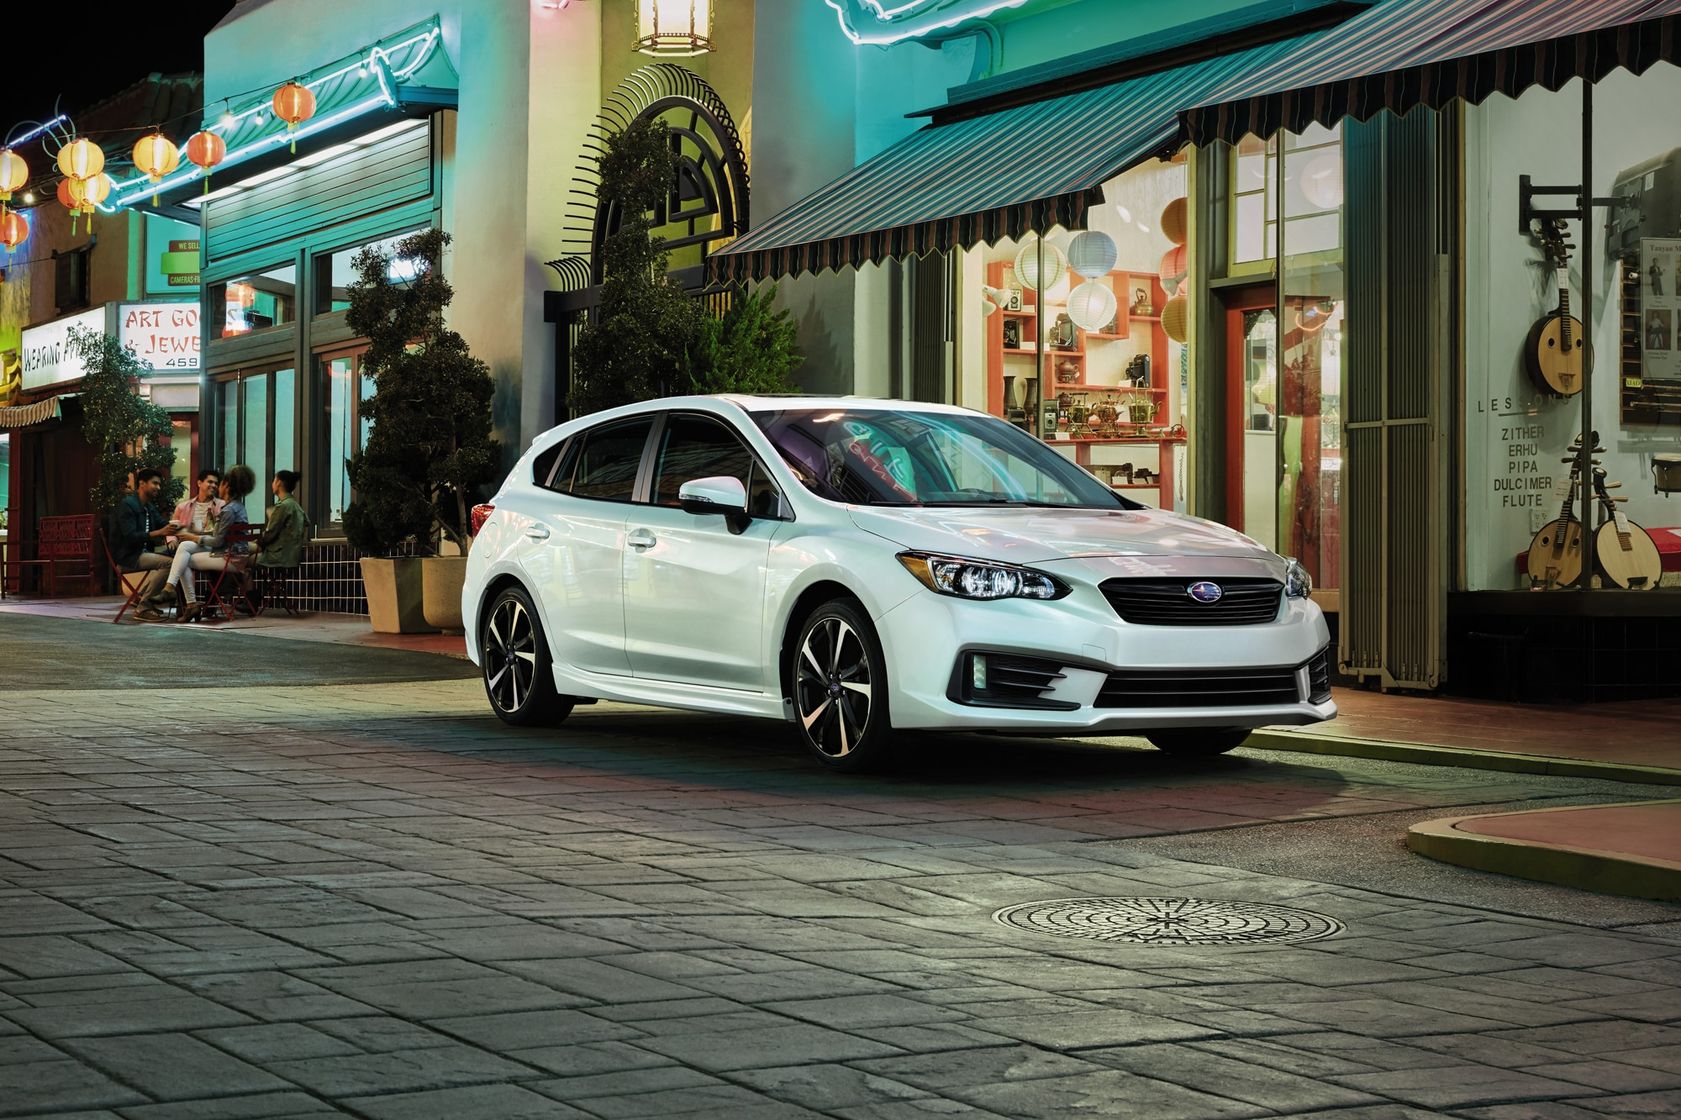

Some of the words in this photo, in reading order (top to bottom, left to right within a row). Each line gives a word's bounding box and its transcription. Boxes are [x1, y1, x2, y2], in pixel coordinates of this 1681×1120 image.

[178, 242, 188, 250] WE
[125, 310, 163, 328] ART
[23, 341, 60, 372] WEARING
[166, 357, 198, 367] 459
[1501, 425, 1545, 441] ZITHER
[1508, 443, 1538, 457] ERHU
[1508, 460, 1538, 474] PIPA
[1493, 476, 1552, 491] DULCIMER
[1502, 494, 1542, 508] FLUTE
